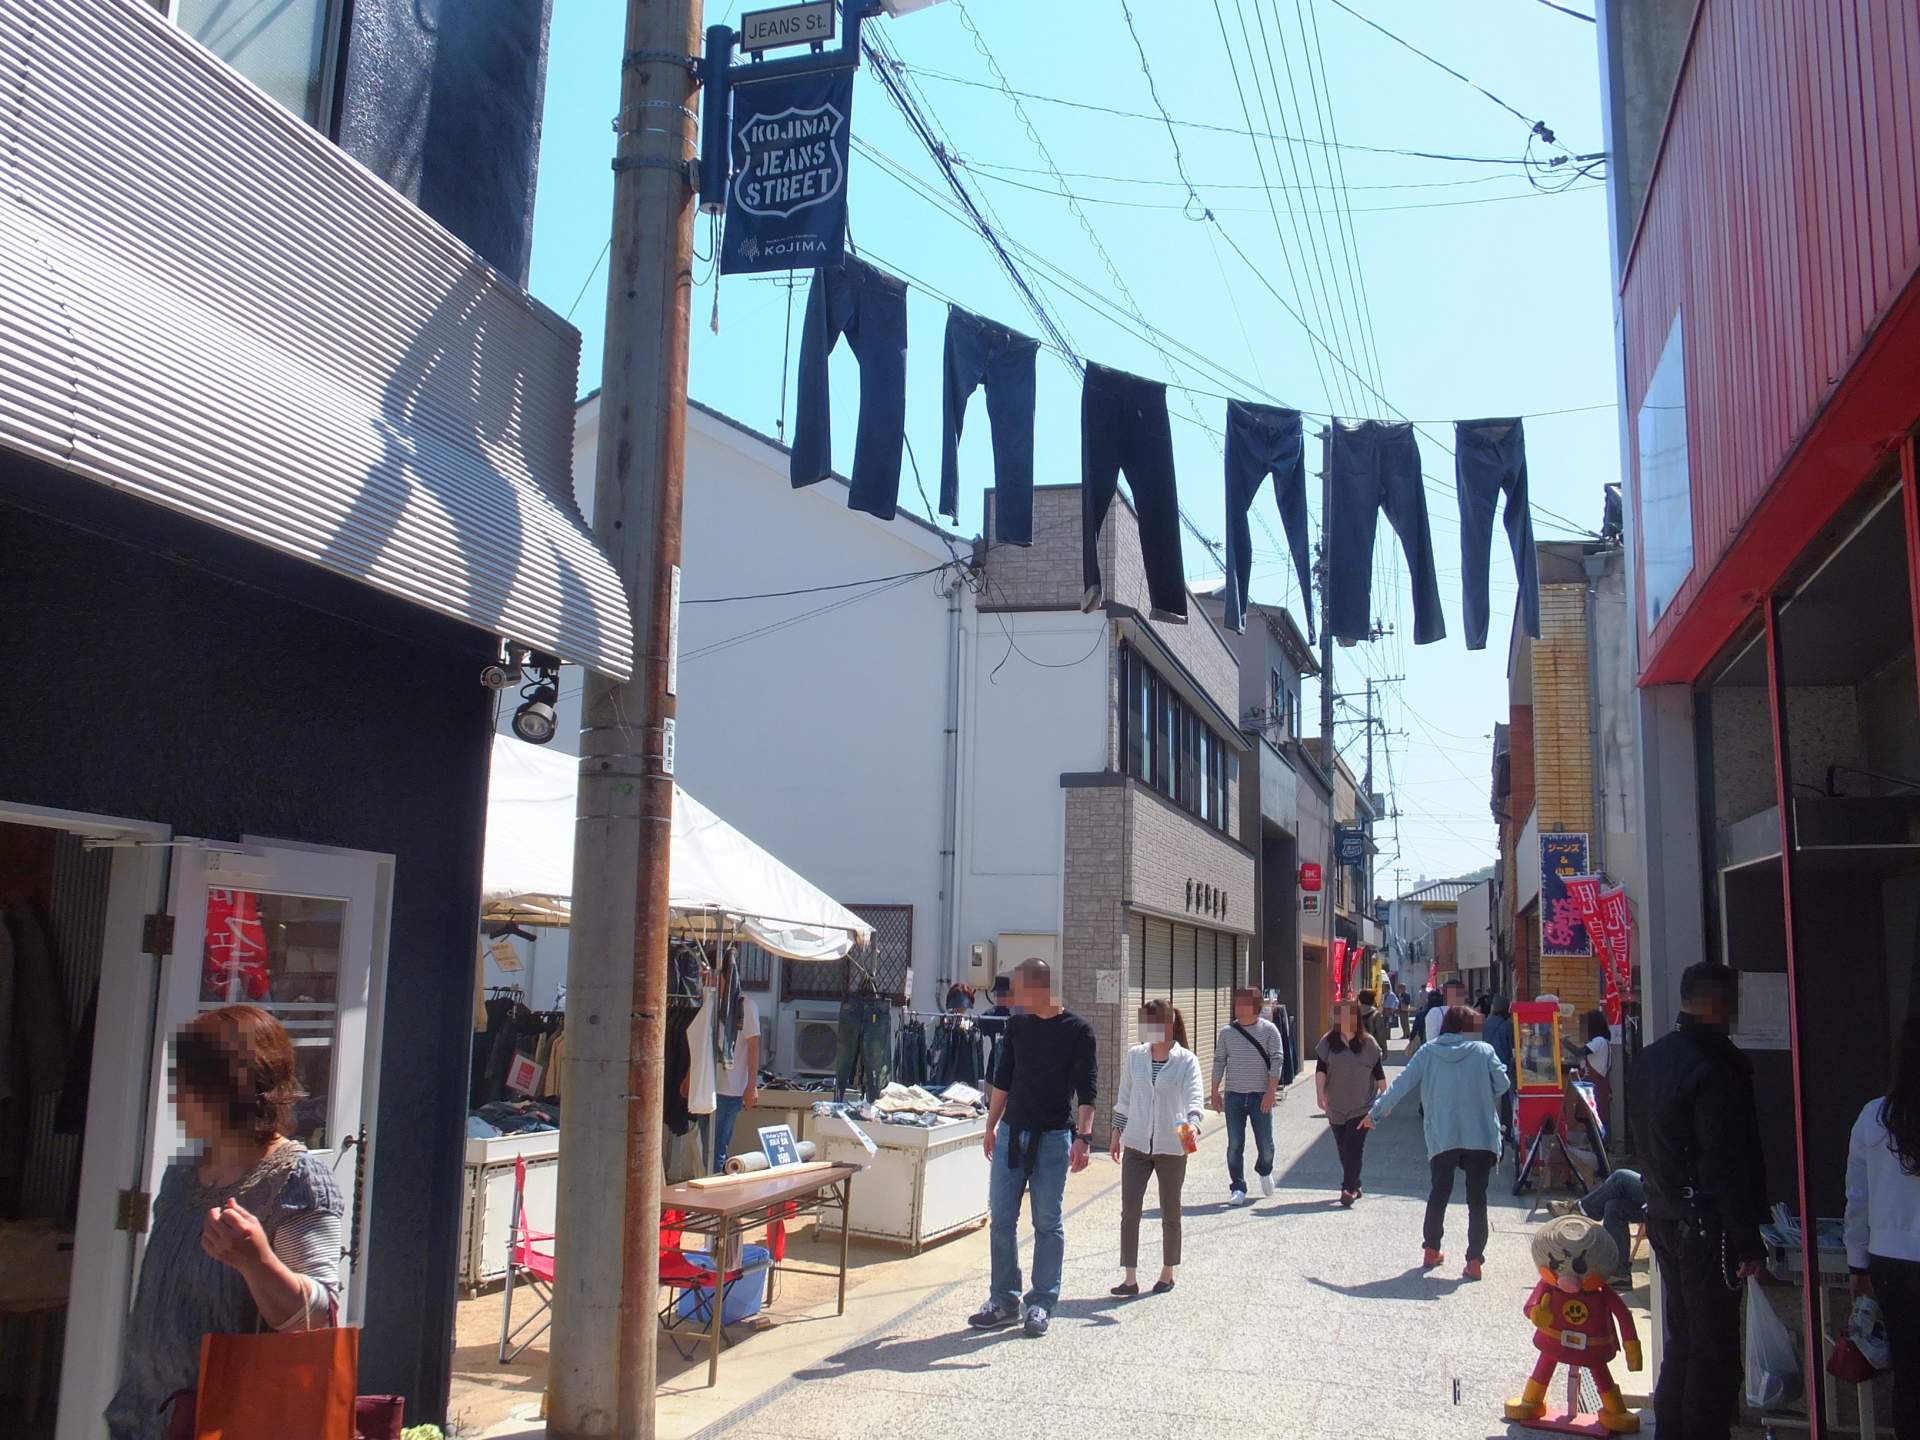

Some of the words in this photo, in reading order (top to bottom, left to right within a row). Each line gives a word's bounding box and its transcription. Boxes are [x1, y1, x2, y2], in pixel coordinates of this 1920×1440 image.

[748, 17, 800, 39] JEANS
[806, 14, 827, 30] St.
[751, 115, 832, 143] KOJIMA
[755, 141, 826, 177] JEANS
[745, 168, 832, 206] STREET
[764, 240, 828, 256] KOJIMA
[1548, 843, 1580, 853] ジーンズ
